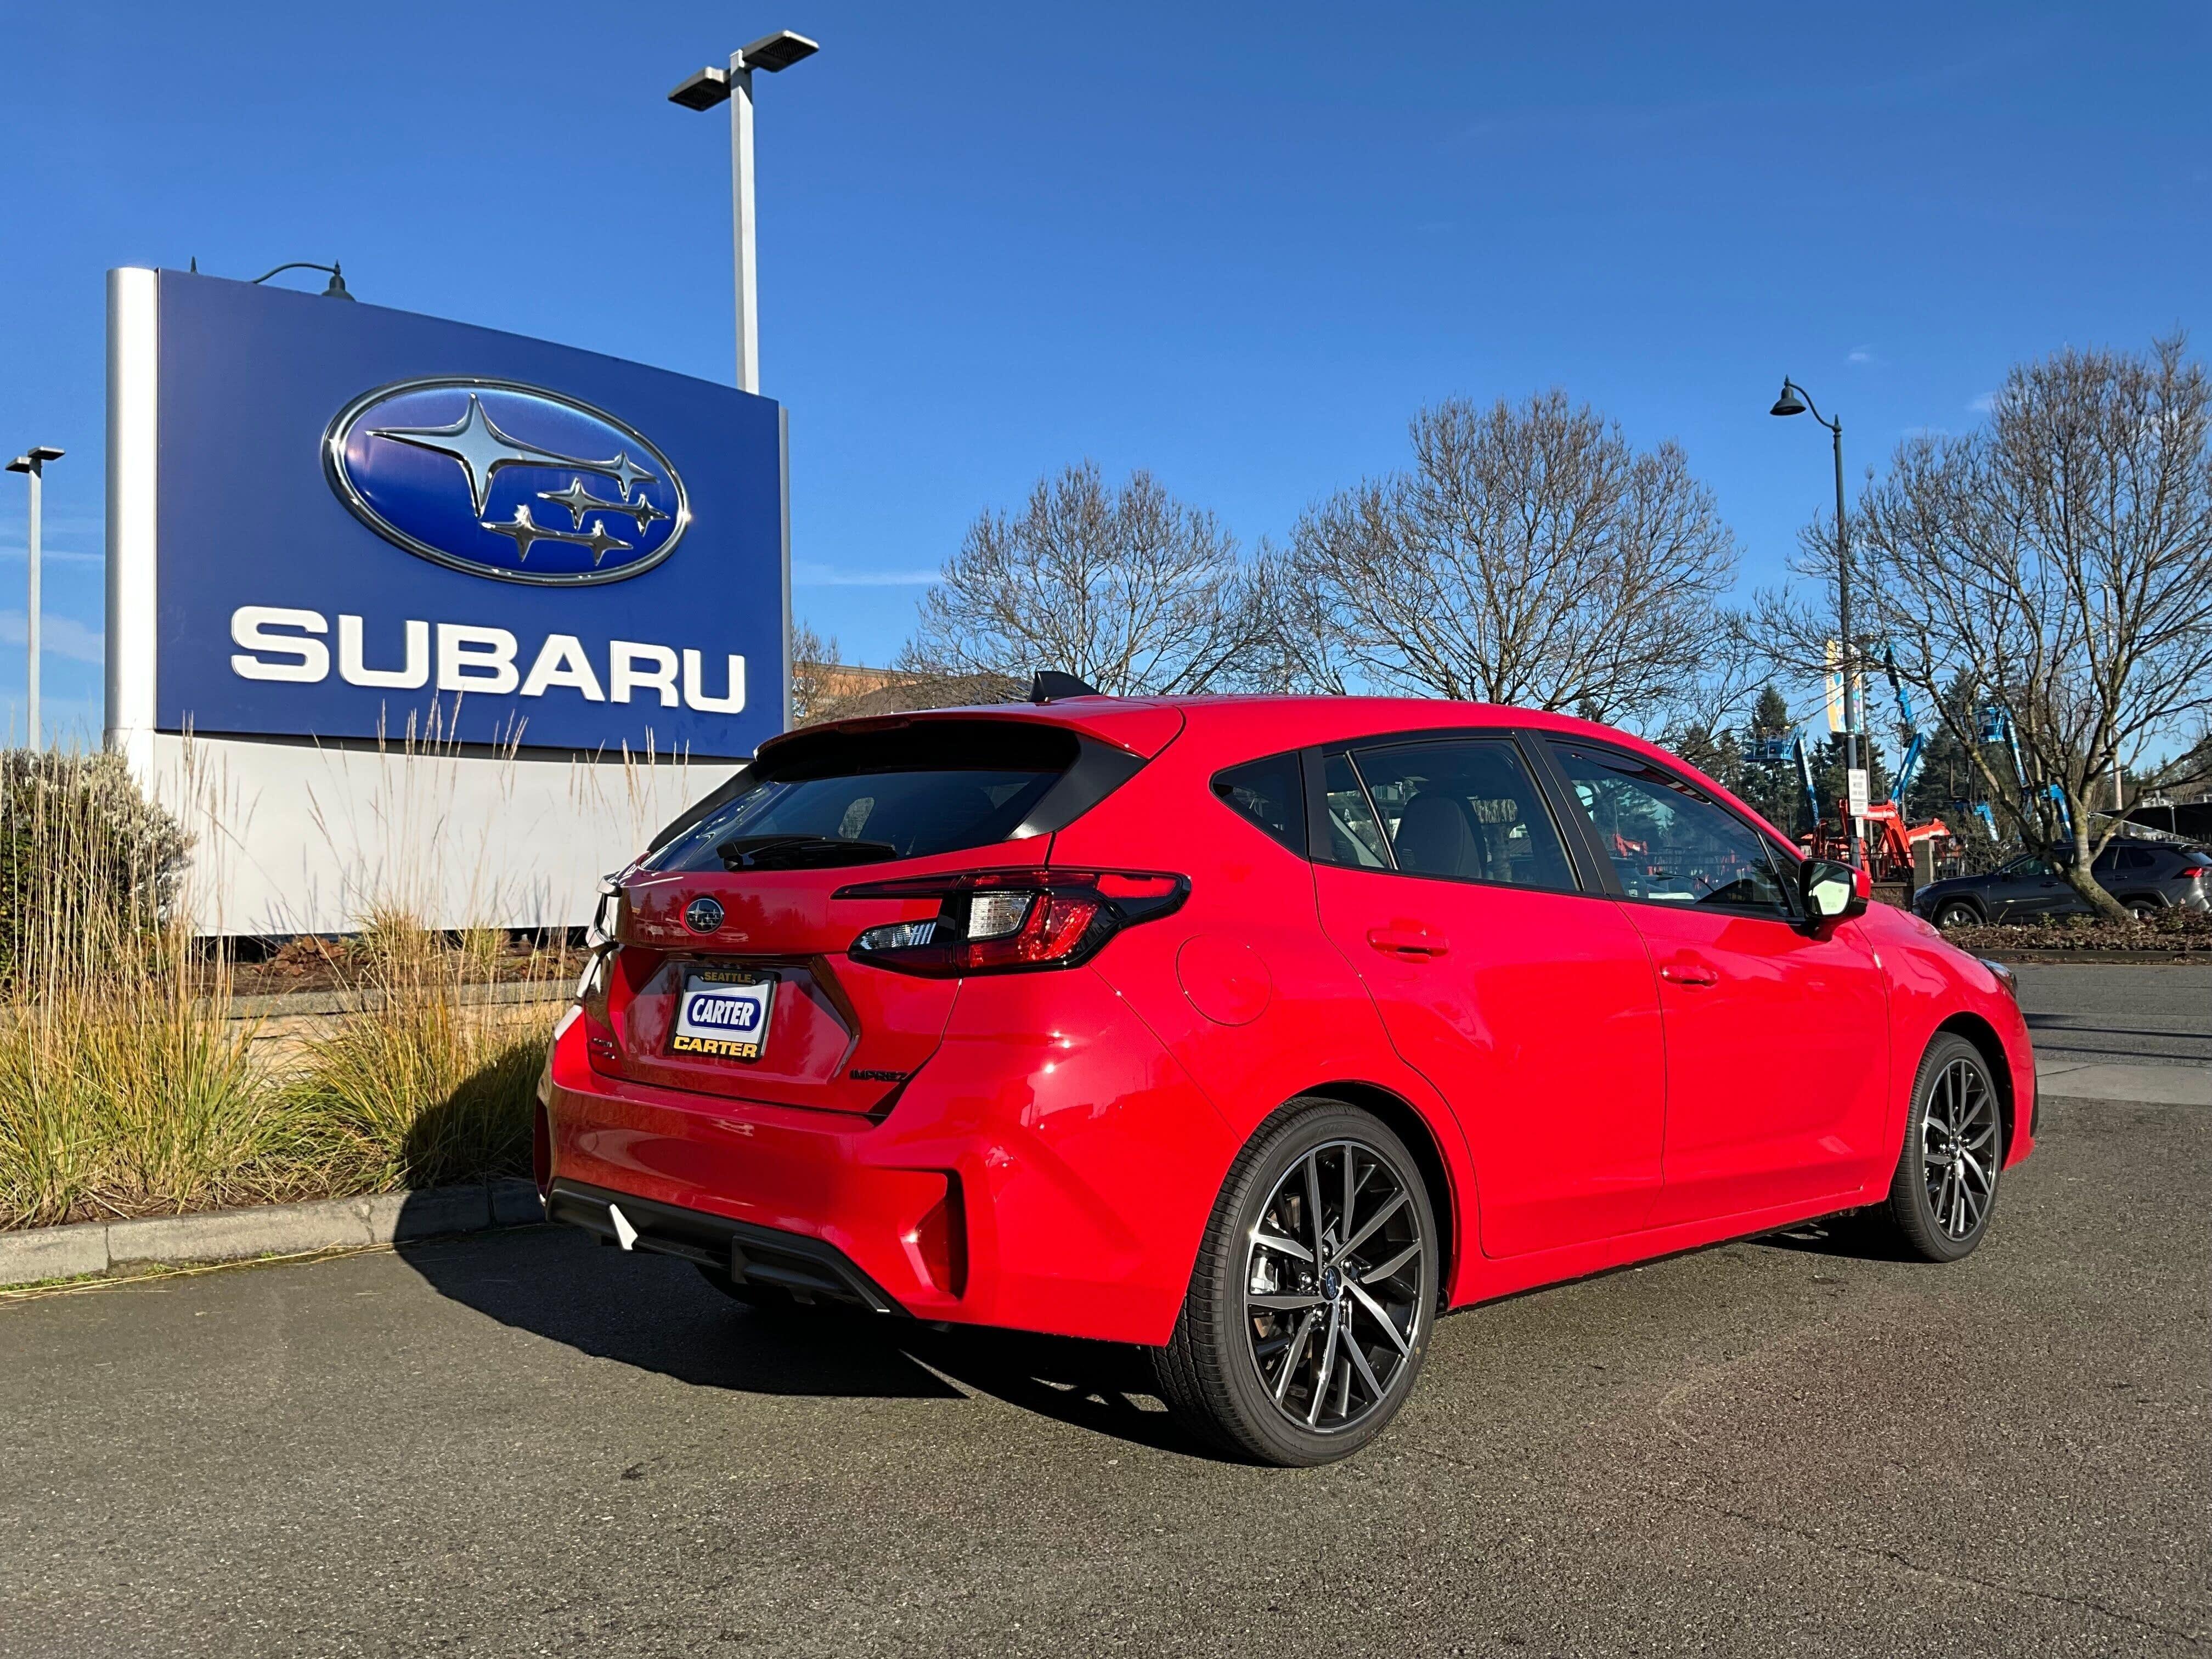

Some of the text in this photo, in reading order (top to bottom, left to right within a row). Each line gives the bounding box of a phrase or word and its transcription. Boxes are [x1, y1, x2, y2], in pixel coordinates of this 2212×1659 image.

[231, 606, 746, 714] SUBARU
[704, 971, 752, 983] SEATTLE
[692, 998, 754, 1026] CARTER
[673, 1036, 758, 1058] CARTER
[850, 1069, 909, 1082] IMPREZ
